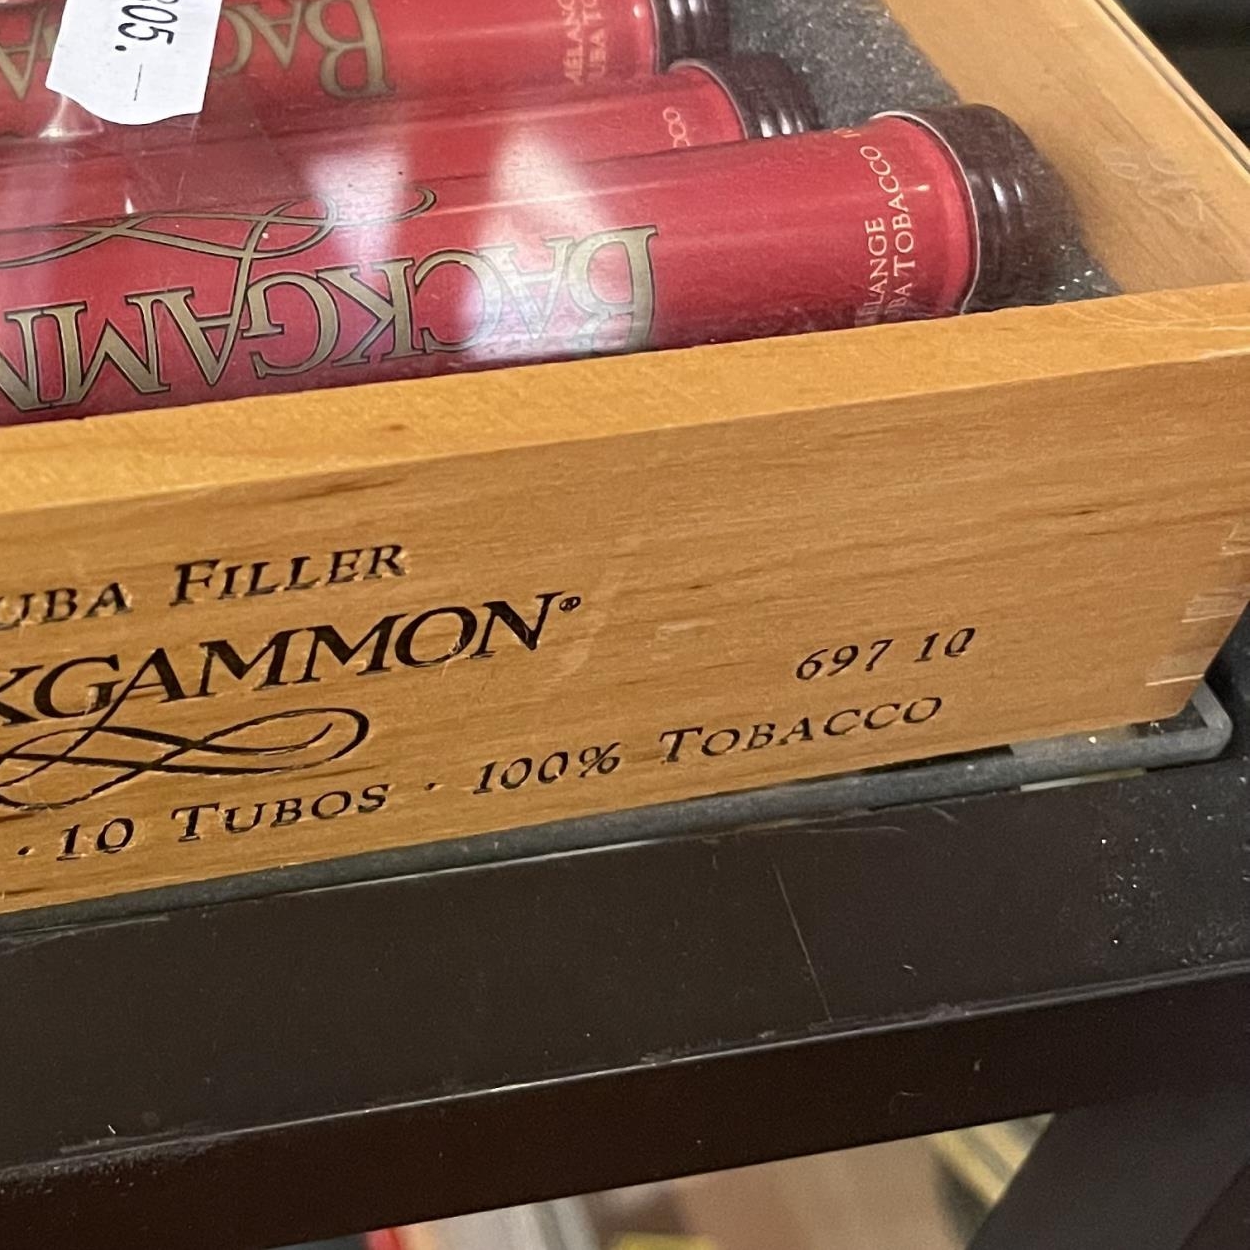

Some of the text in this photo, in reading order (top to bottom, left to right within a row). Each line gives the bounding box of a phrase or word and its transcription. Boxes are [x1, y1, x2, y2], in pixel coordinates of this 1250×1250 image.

[859, 145, 915, 277] TOBACCO
[168, 539, 411, 608] FILLER
[795, 625, 978, 682] 697 10
[57, 816, 136, 862] 10
[170, 783, 391, 843] TUBOS
[471, 741, 623, 796] 100%
[657, 695, 944, 766] TOBACCO
